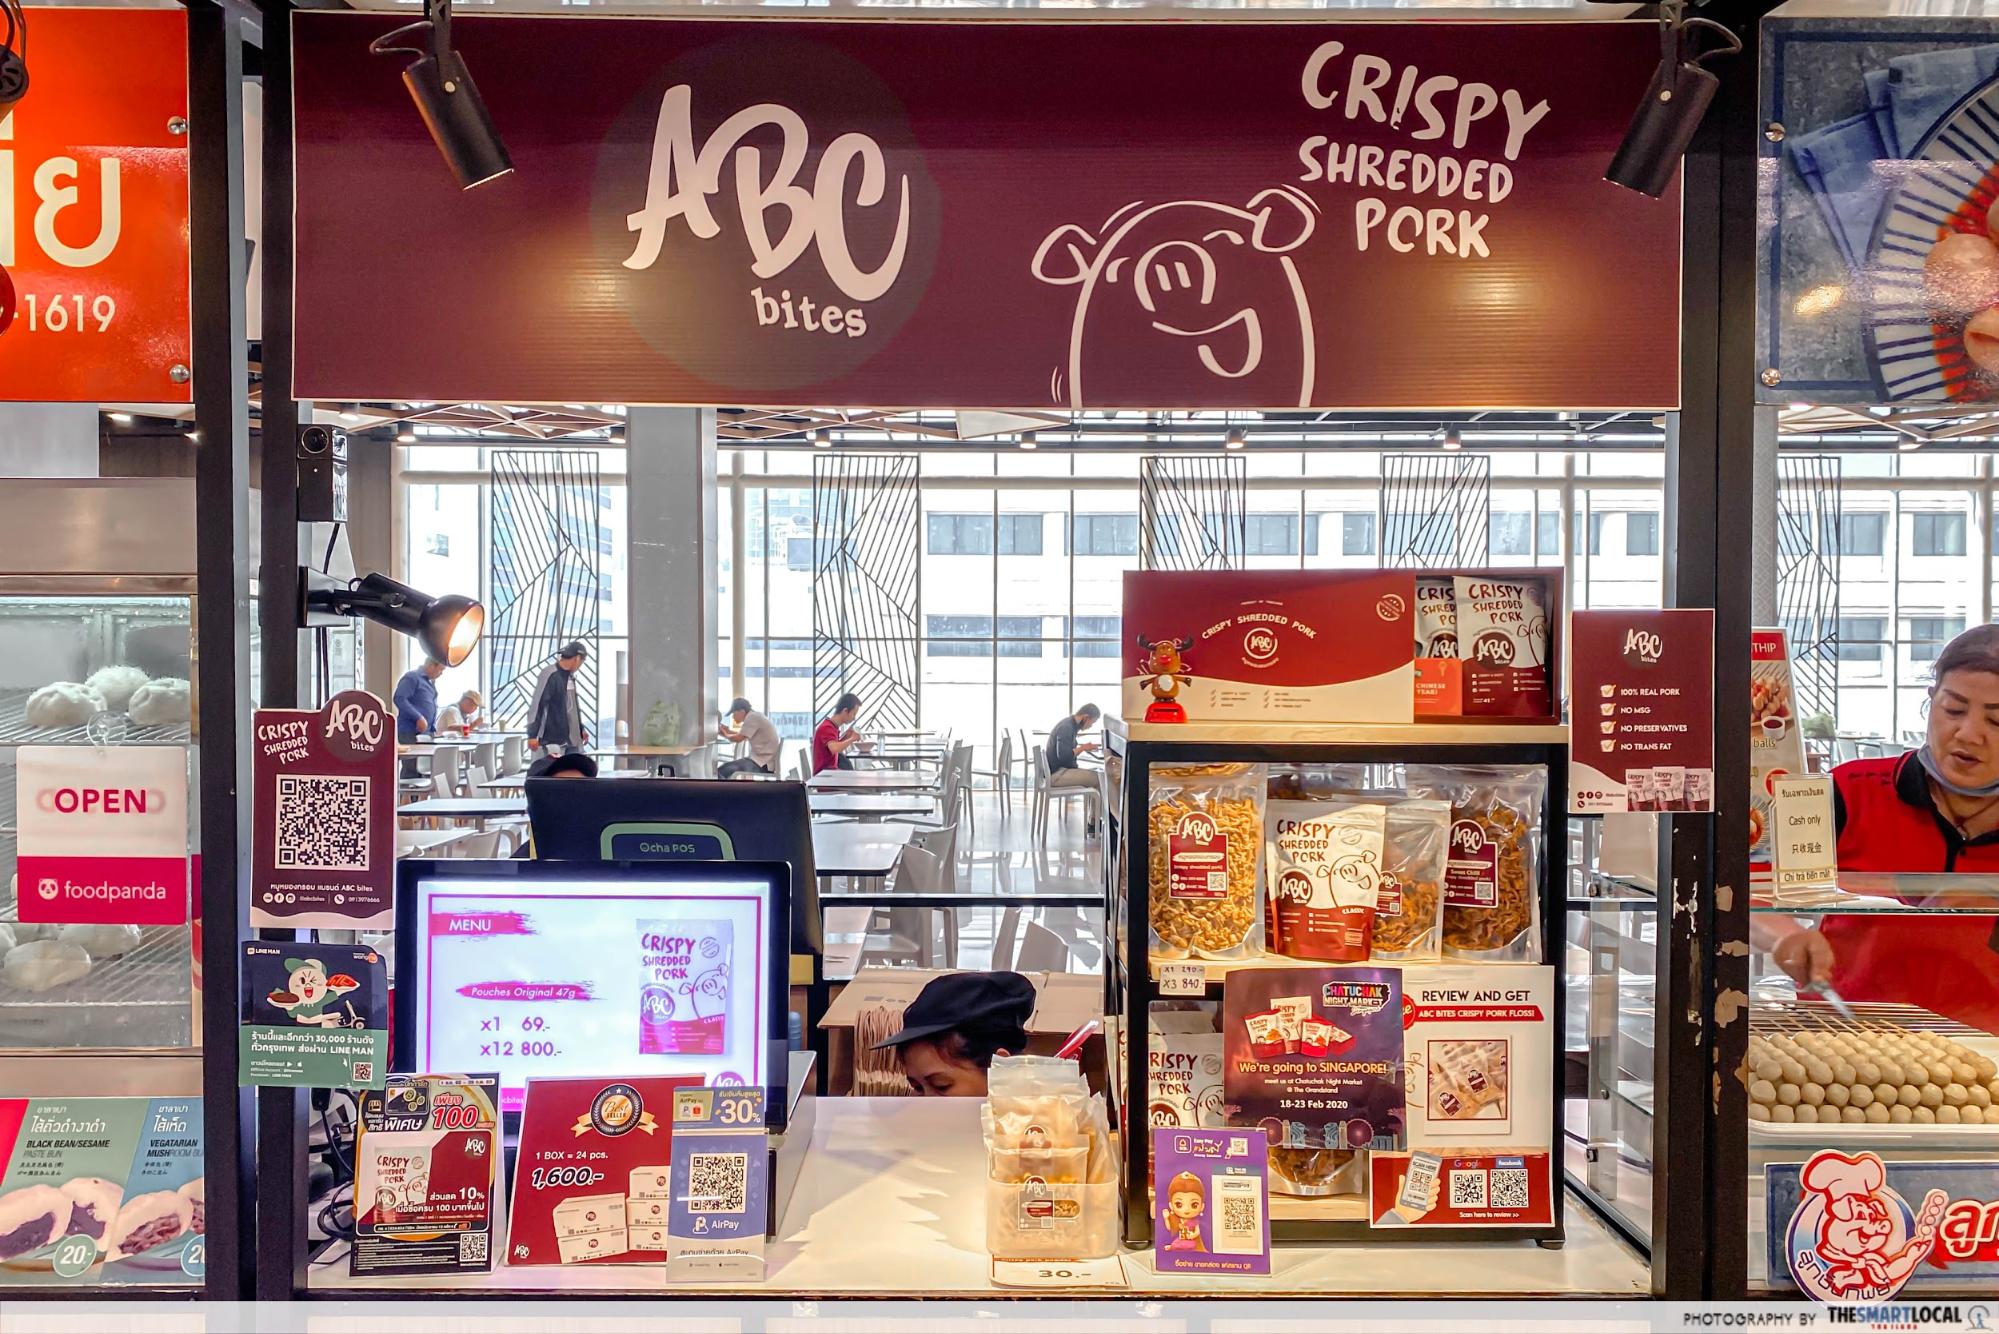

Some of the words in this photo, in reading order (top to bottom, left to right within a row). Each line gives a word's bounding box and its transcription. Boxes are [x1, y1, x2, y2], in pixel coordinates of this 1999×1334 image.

[1302, 41, 1551, 161] CRISPY
[1299, 135, 1513, 204] SHREDDED
[622, 84, 910, 302] ABC
[1356, 197, 1491, 258] PORK
[751, 287, 867, 338] bites
[1418, 586, 1455, 601] CRIS
[1469, 583, 1524, 600] CRISPY
[1421, 603, 1456, 616] SHRED
[1472, 600, 1523, 614] SHREDDED
[1489, 611, 1524, 625] PORK
[1201, 619, 1232, 640] CRISPY
[1237, 613, 1288, 625] SHREDDED
[1291, 621, 1317, 640] PORK
[1623, 628, 1663, 658] ABC
[1477, 638, 1514, 662] ABC
[325, 700, 384, 745] ABC
[258, 720, 309, 741] CRISPY
[264, 737, 309, 756] SHREDDED
[350, 741, 375, 752] bites
[1753, 738, 1776, 748] balls
[279, 748, 310, 765] PORK
[54, 788, 147, 813] OPEN
[1789, 815, 1806, 826] Cash
[1807, 814, 1821, 825] only
[1182, 818, 1214, 843] ABC
[1276, 819, 1336, 839] CRISPY
[1452, 826, 1483, 850] ABC
[640, 842, 670, 853] Ocha
[672, 843, 695, 853] POS
[1279, 840, 1329, 850] SHREDDED
[1792, 842, 1822, 855] 只收现金
[1292, 852, 1326, 864] PORK
[64, 880, 166, 903] foodpanda
[357, 884, 374, 892] bites
[1280, 878, 1311, 900] ABC
[449, 919, 492, 931] MENU
[641, 933, 696, 955] CRISPY
[642, 955, 691, 966] SHREDDED
[655, 968, 689, 980] PORK
[471, 987, 511, 996] Pouches
[513, 987, 553, 999] Original
[556, 988, 576, 999] 47g
[1324, 984, 1383, 998] CHATUCHAK
[1422, 990, 1470, 1002] REVIEW
[1473, 990, 1501, 1002] AND
[1505, 990, 1531, 1001] GET
[643, 993, 673, 1016] ABC
[1324, 997, 1349, 1006] NIGHT
[1350, 997, 1384, 1006] MARKET
[1418, 1010, 1434, 1018] ABC
[1436, 1010, 1456, 1018] BITES
[1457, 1010, 1484, 1018] CRISPY
[1486, 1010, 1507, 1018] PORK
[1509, 1009, 1535, 1017] FLOSS!
[480, 1016, 500, 1031] x1
[521, 1016, 550, 1032] 69.-
[315, 1034, 346, 1044] 30,000
[330, 1046, 351, 1054] LINE
[352, 1047, 374, 1055] MAN
[480, 1041, 513, 1056] x12
[520, 1041, 562, 1056] 800.-
[1149, 1052, 1198, 1071] RISPY
[1239, 1062, 1270, 1073] We're
[1272, 1062, 1304, 1075] going
[1307, 1063, 1317, 1073] to
[1319, 1062, 1387, 1074] SINGAPORE!
[1149, 1070, 1193, 1081] HREDDED
[1326, 1078, 1341, 1086] Night
[1159, 1083, 1191, 1095] PORK
[1279, 1100, 1306, 1108] 18-23
[1308, 1100, 1324, 1108] Feb
[1326, 1100, 1349, 1109] 2020
[432, 1105, 479, 1129] 100
[720, 1099, 761, 1124] 30%
[153, 1114, 187, 1133] ไส้เห็ด
[26, 1140, 52, 1148] BLACK
[54, 1140, 111, 1148] BEAN/SESAME
[150, 1139, 199, 1148] VEGATARIAN
[465, 1138, 486, 1154] ABC
[23, 1150, 45, 1158] PASTE
[47, 1150, 63, 1158] BUN
[146, 1149, 191, 1158] MUSHROOM
[544, 1152, 564, 1160] BOX
[576, 1151, 587, 1159] 24
[590, 1151, 609, 1161] pcs.
[377, 1155, 410, 1168] CRISPY
[377, 1168, 407, 1176] SHREDDED
[532, 1166, 605, 1190] 1,600.-
[384, 1176, 405, 1184] PORK
[459, 1187, 485, 1201] 10%
[436, 1204, 450, 1212] 100
[711, 1220, 739, 1231] AirPay
[1038, 1270, 1092, 1278] 30.-
